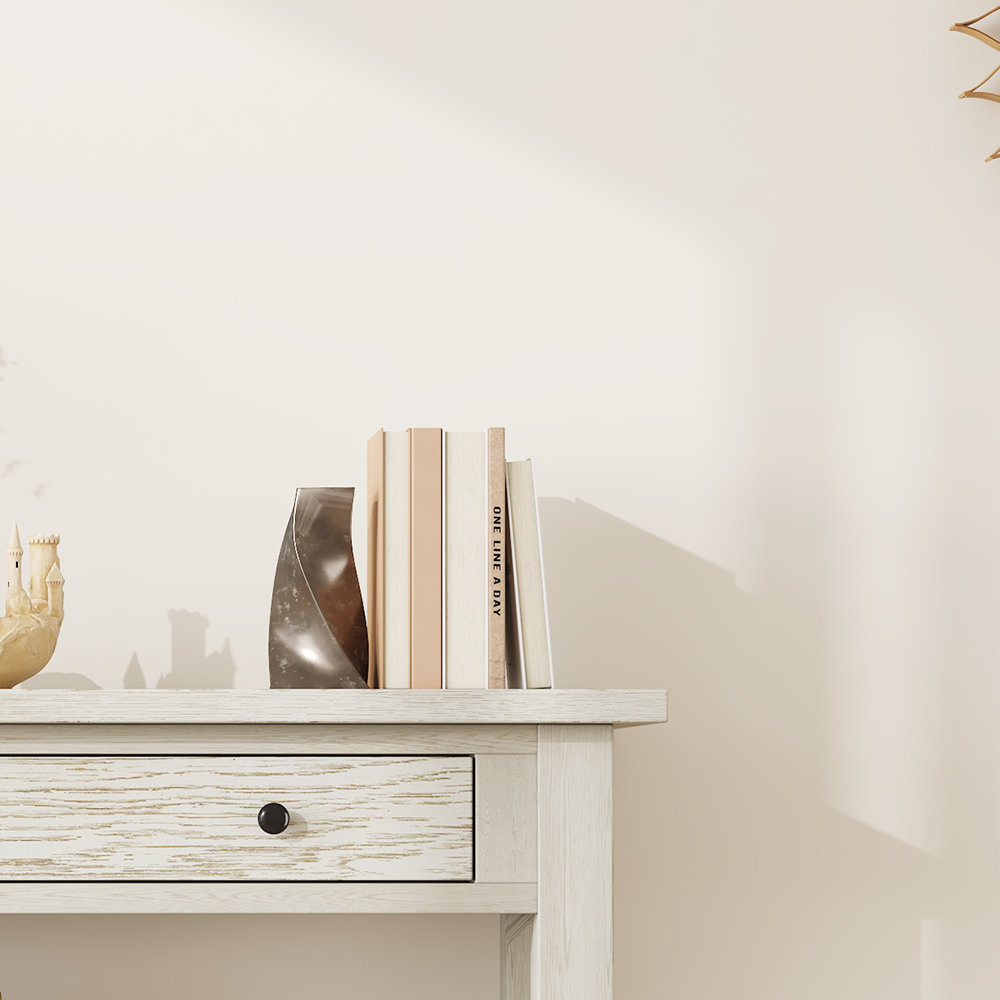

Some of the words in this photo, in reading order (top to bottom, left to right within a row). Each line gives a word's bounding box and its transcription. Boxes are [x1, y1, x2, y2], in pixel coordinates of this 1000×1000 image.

[493, 506, 501, 533] ONE
[493, 540, 501, 571] LINE
[493, 576, 501, 585] A
[493, 590, 501, 616] DAY
